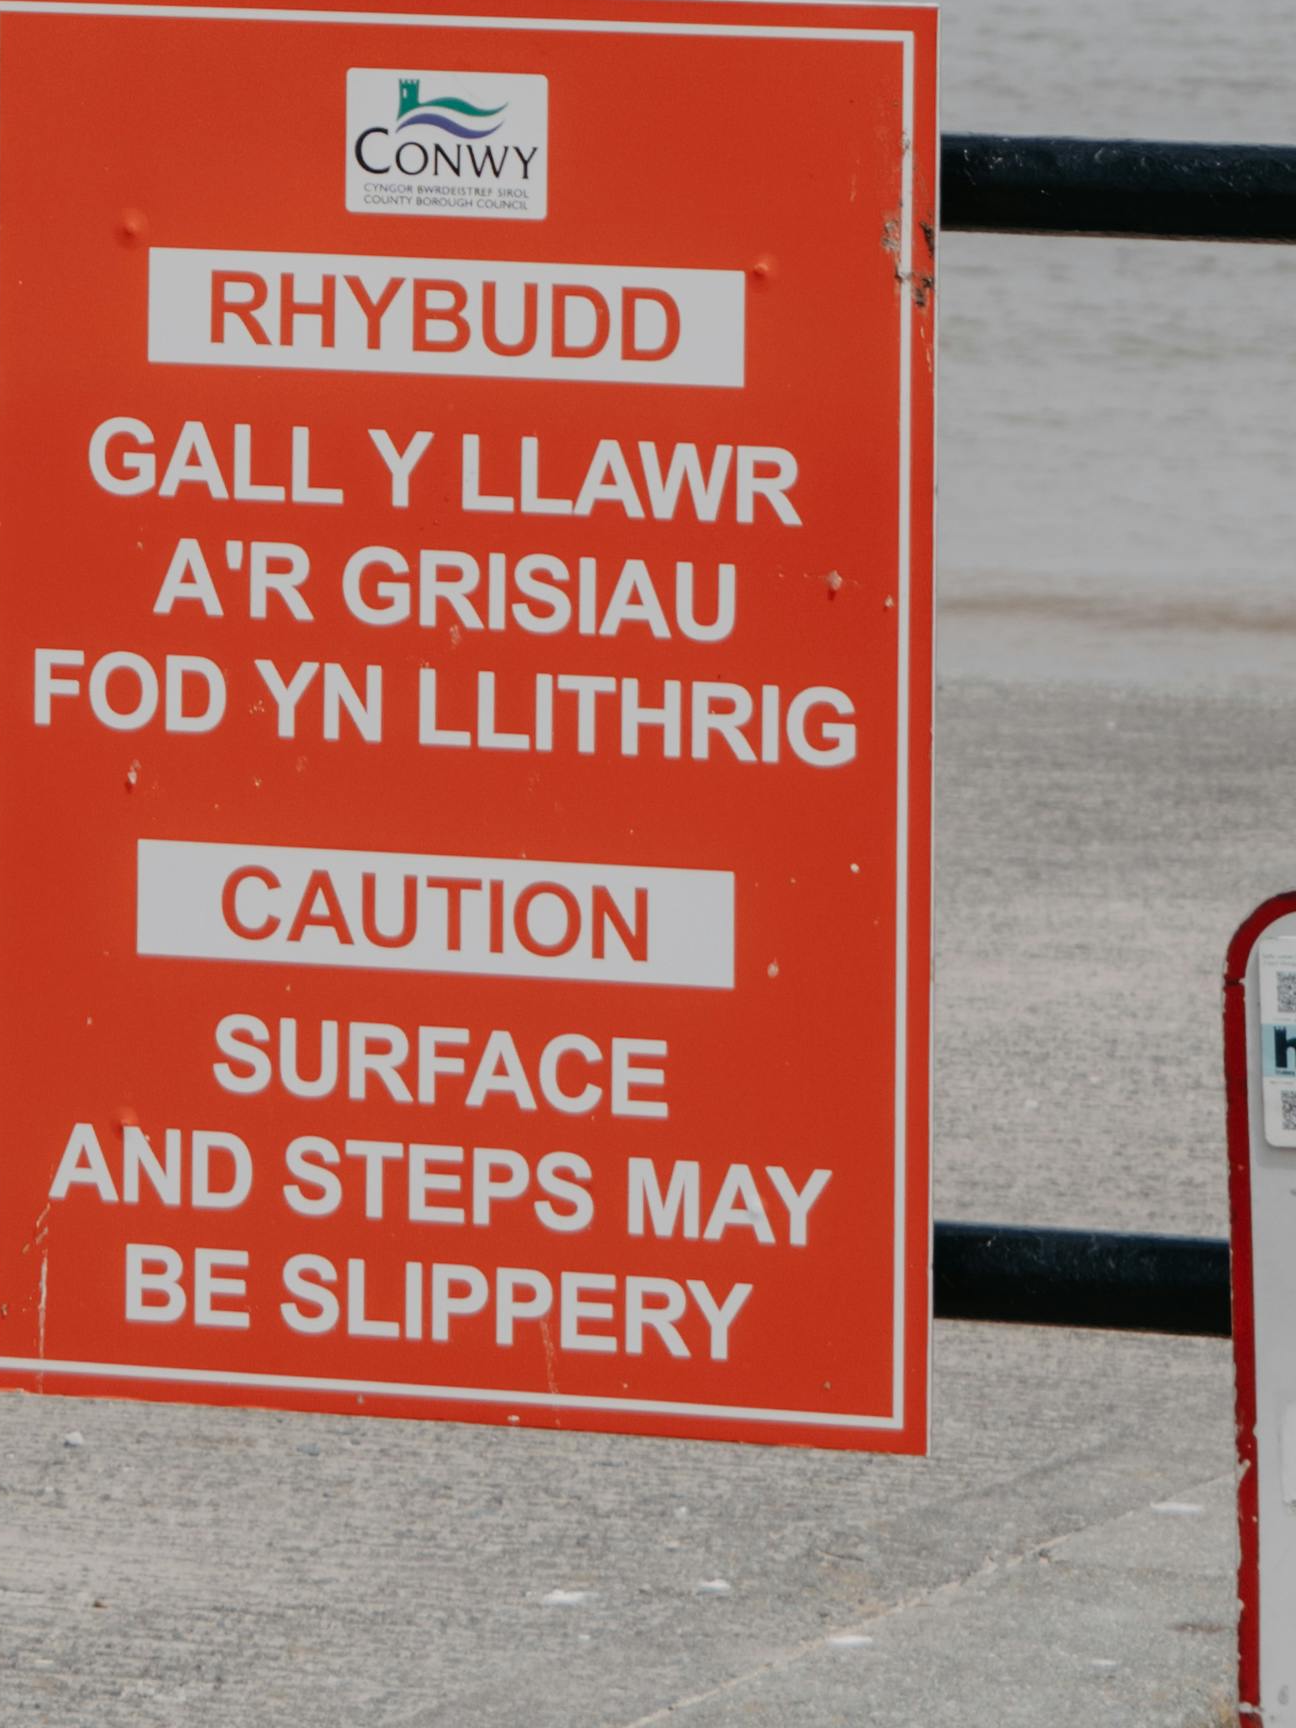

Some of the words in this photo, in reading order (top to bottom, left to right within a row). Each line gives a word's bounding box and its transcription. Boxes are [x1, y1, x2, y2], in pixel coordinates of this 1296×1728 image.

[363, 182, 413, 194] CYNGOR
[416, 184, 493, 197] BWRDEISTREF
[497, 187, 529, 199] SIROL
[363, 194, 413, 205] COUNTY
[416, 196, 473, 208] BOROUGH
[476, 198, 528, 210] COUNCIL
[210, 270, 681, 362] RHYBUDD
[88, 416, 345, 505] GALL
[367, 428, 435, 509] Y
[461, 433, 803, 527] LLAWR
[152, 537, 315, 622] A'R
[341, 545, 737, 643] GRISIAU
[33, 647, 227, 734] FOD
[253, 658, 383, 744] YN
[418, 666, 857, 769] LLITHRIG
[221, 865, 649, 963] CAUTION
[212, 1013, 669, 1119] SURFACE
[47, 1122, 254, 1210] AND
[282, 1135, 595, 1234] STEPS
[627, 1156, 833, 1247] MAY
[124, 1242, 251, 1330] BE
[279, 1253, 754, 1361] SLIPPERY
